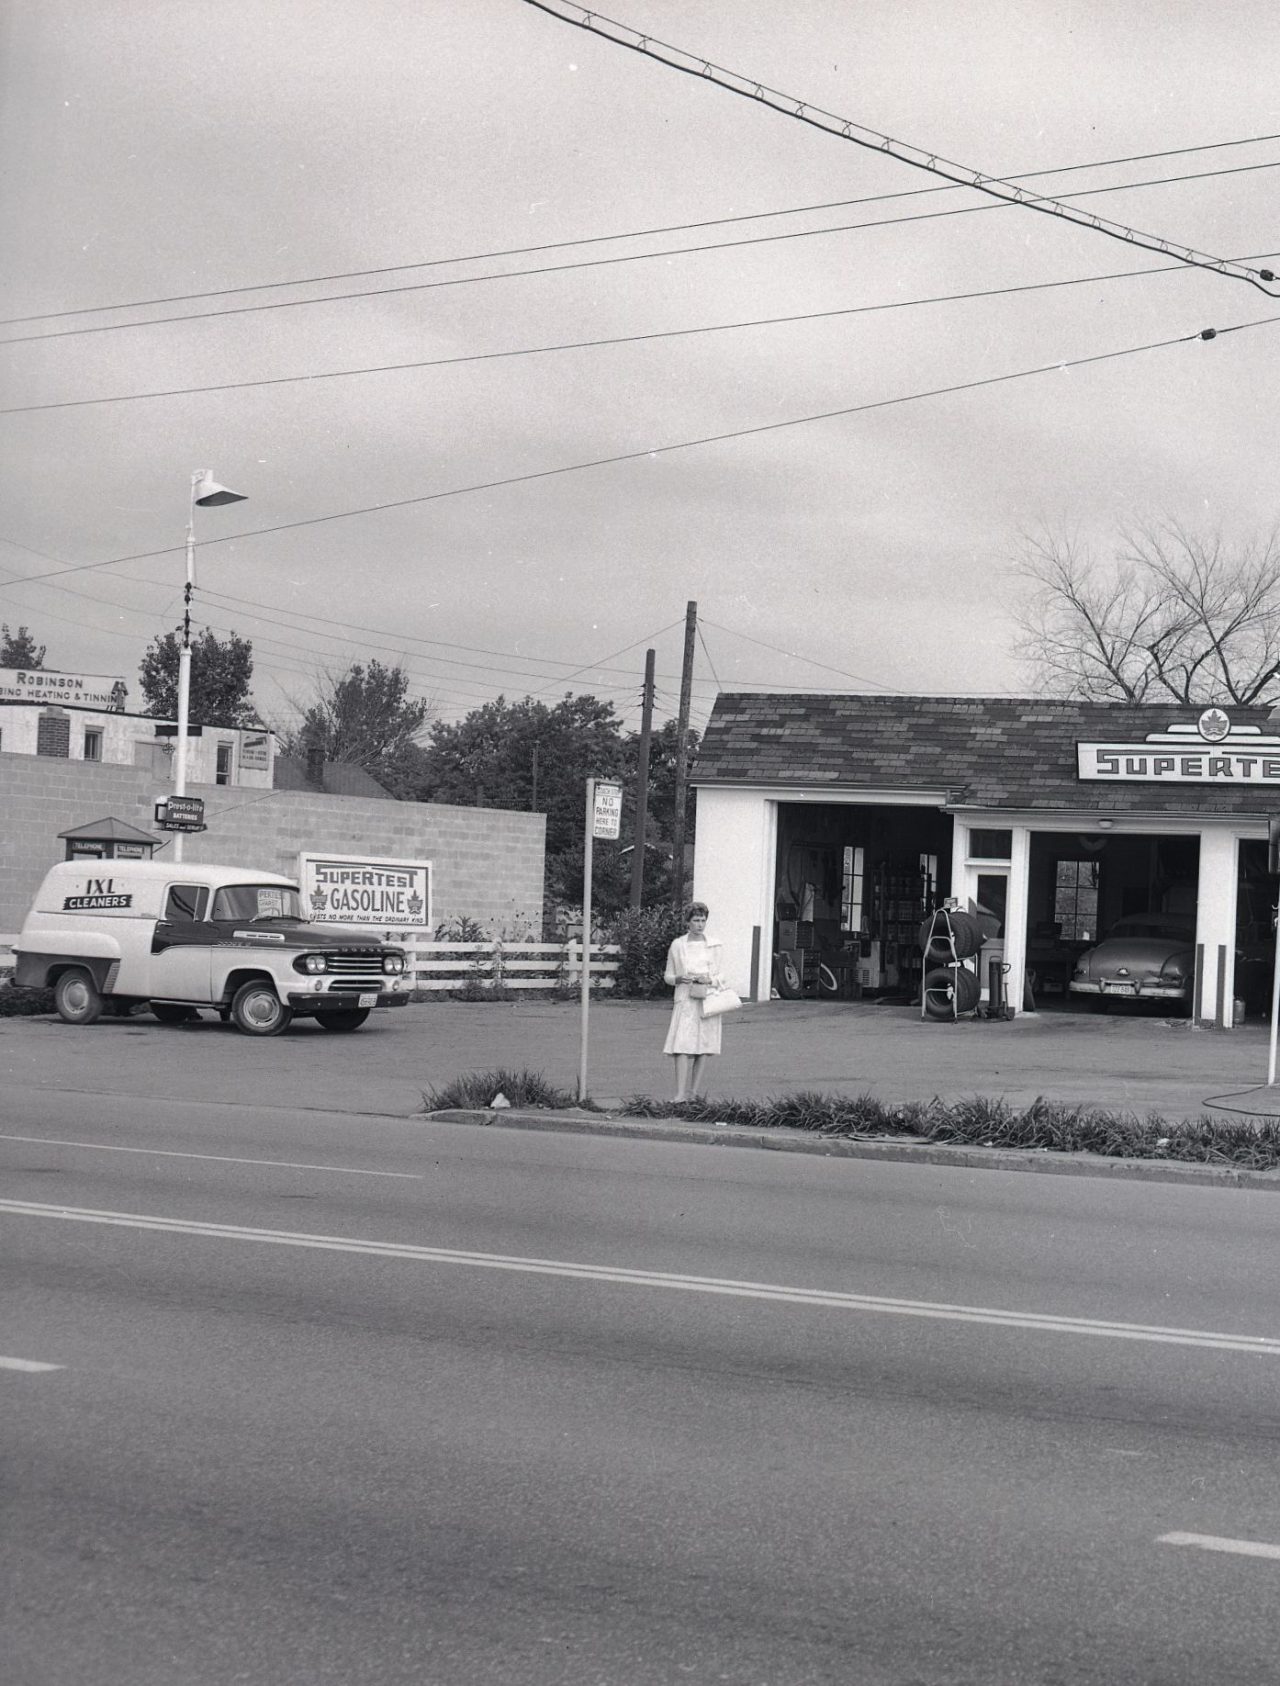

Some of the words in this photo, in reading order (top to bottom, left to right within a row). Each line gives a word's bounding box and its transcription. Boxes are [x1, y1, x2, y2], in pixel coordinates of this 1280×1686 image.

[17, 672, 83, 689] ROBINSON
[27, 689, 71, 700] HEATING
[74, 693, 81, 701] &
[83, 693, 119, 704] TINNIN
[602, 797, 614, 807] NO
[595, 806, 619, 817] PARKING
[595, 817, 609, 826] HERE
[595, 826, 618, 836] CORNER
[73, 841, 104, 850] TELEPHONE
[117, 845, 144, 853] TELEPHONE
[316, 863, 418, 888] SUPERTEST
[86, 878, 116, 895] IXL
[69, 896, 127, 908] CLEANERS
[330, 887, 405, 913] GASOLINE
